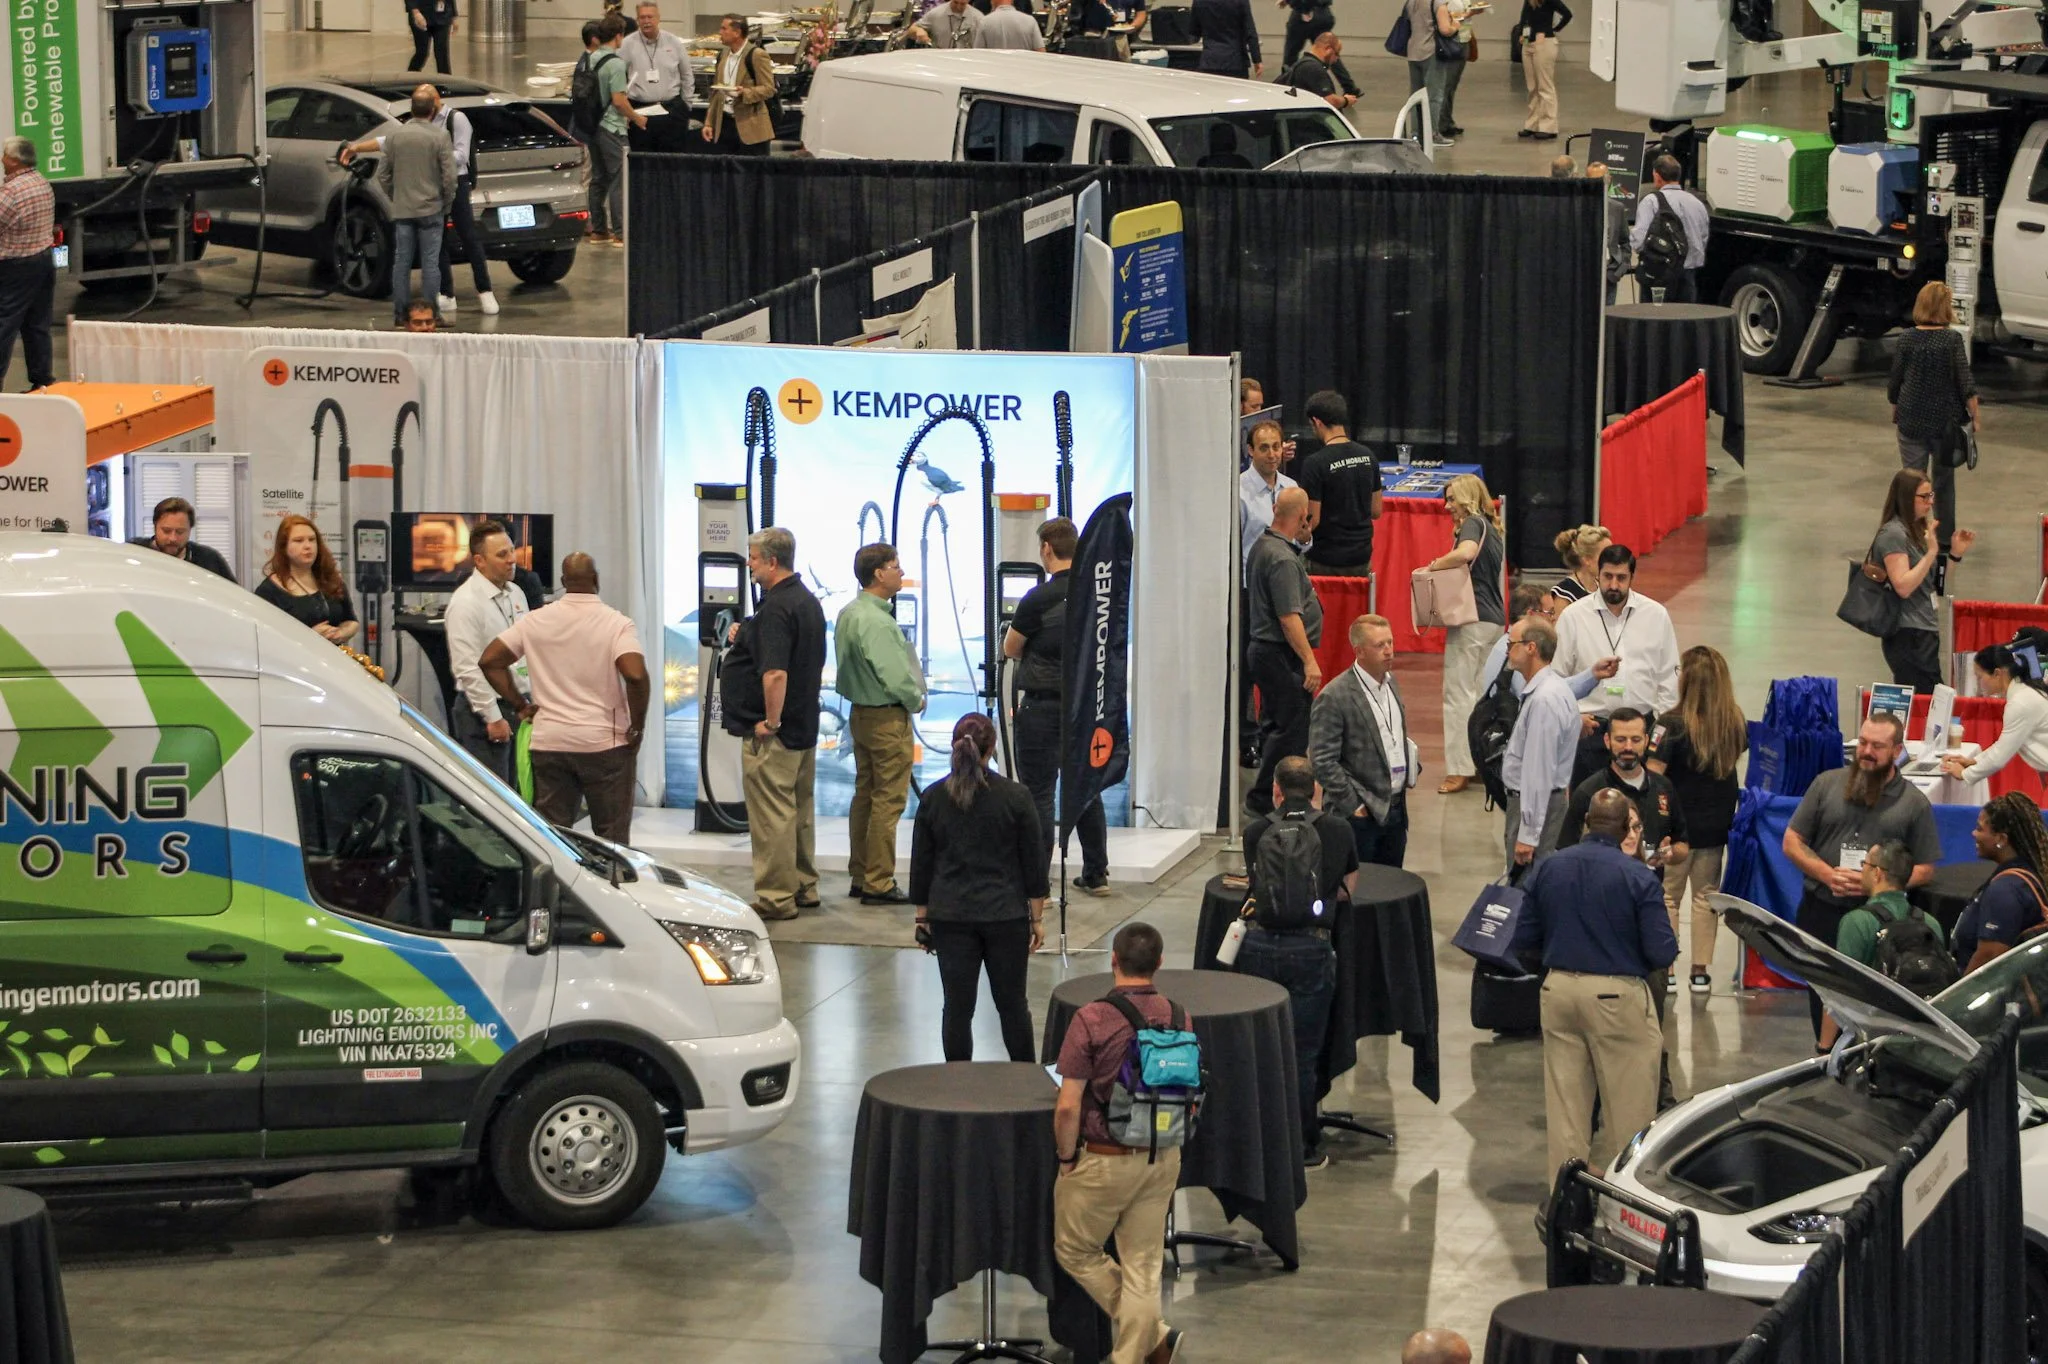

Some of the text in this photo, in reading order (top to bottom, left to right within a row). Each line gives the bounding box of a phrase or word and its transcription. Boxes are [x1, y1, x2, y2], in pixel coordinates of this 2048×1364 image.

[17, 26, 40, 127] Powered
[43, 45, 67, 173] Renewable
[293, 365, 400, 384] KEMPOWER
[833, 390, 1022, 421] KEMPOWER
[1329, 459, 1346, 471] AXLE
[1345, 456, 1370, 466] MOBILITY
[262, 488, 304, 499] Satellite
[15, 515, 32, 528] for
[1095, 559, 1113, 722] KEMPOWER
[331, 1005, 466, 1026] US DOT 2632133
[299, 1023, 498, 1046] LIGHTNING EMOTORS INC
[339, 1042, 456, 1063] VIN NKA75324
